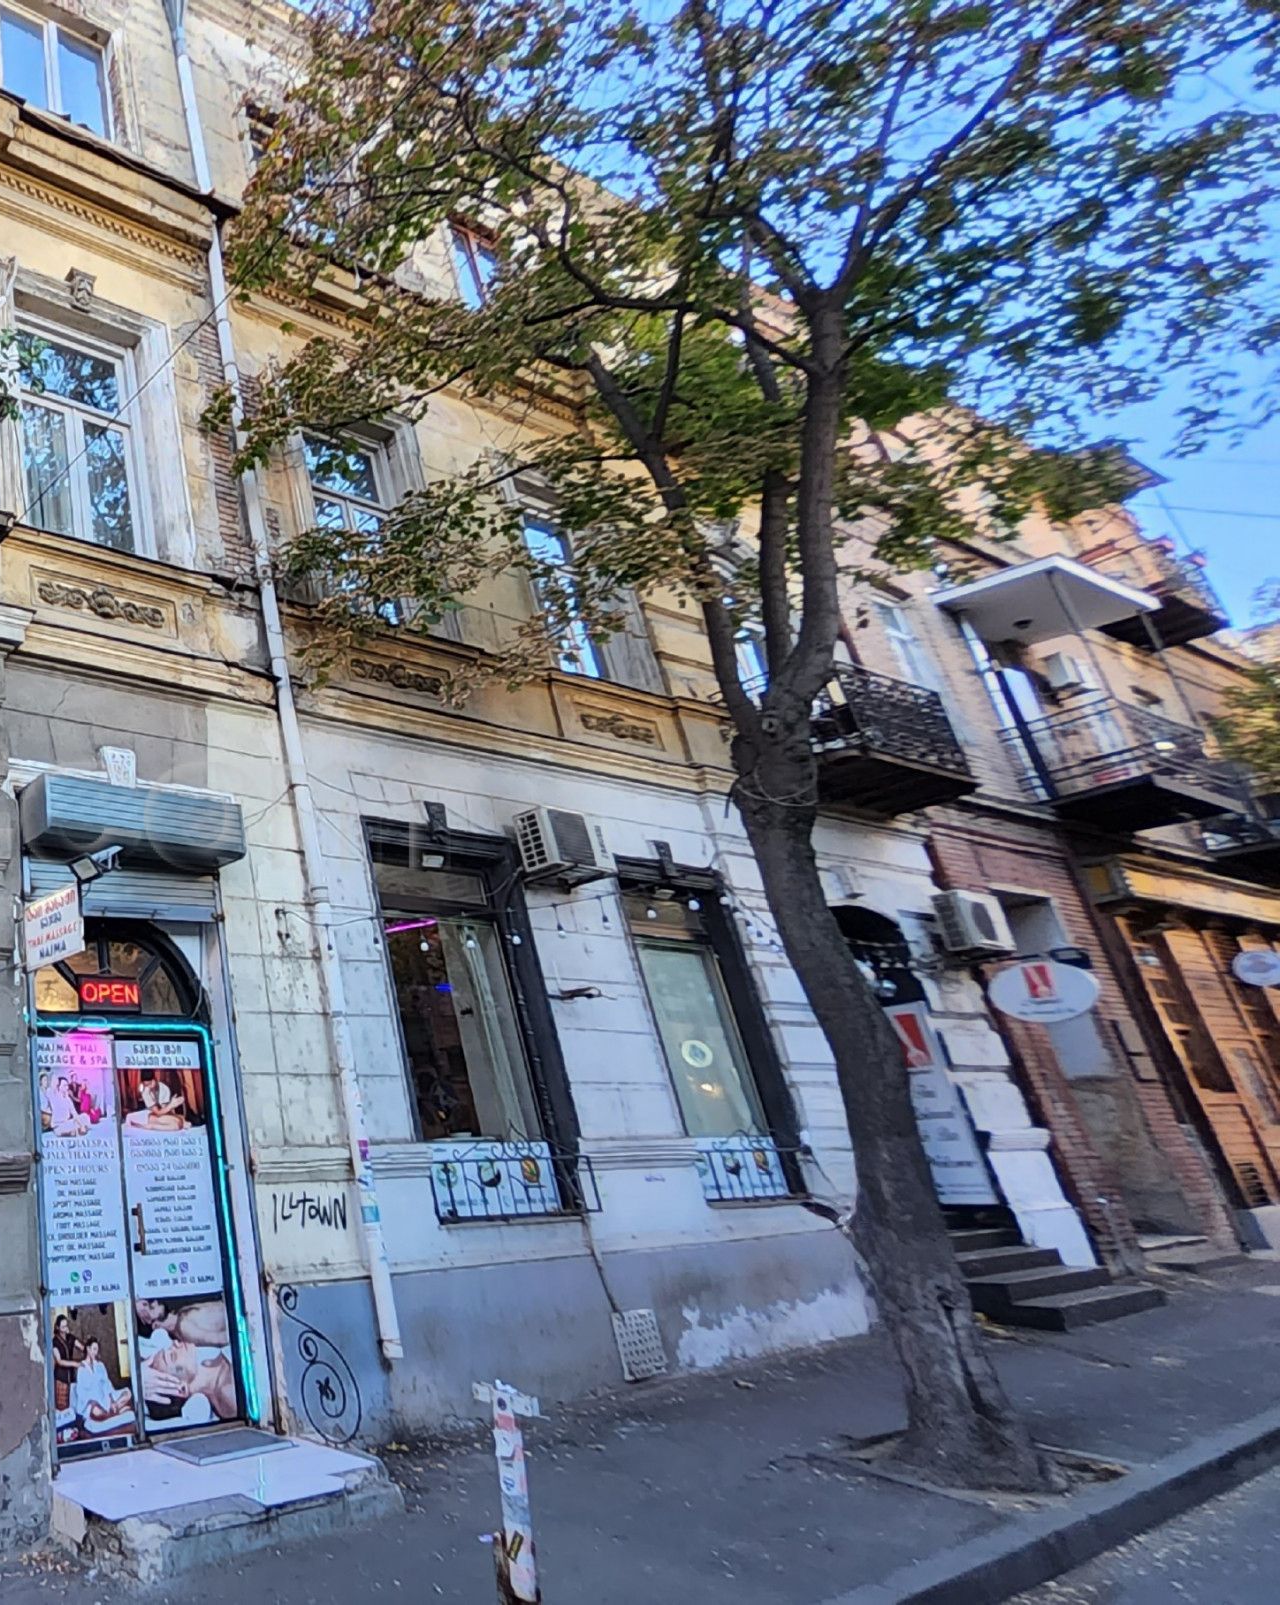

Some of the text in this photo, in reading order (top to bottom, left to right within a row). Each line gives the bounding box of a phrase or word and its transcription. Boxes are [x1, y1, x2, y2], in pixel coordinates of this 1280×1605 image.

[82, 983, 139, 1005] OPEN
[38, 1054, 108, 1065] ASSAGE & SPA
